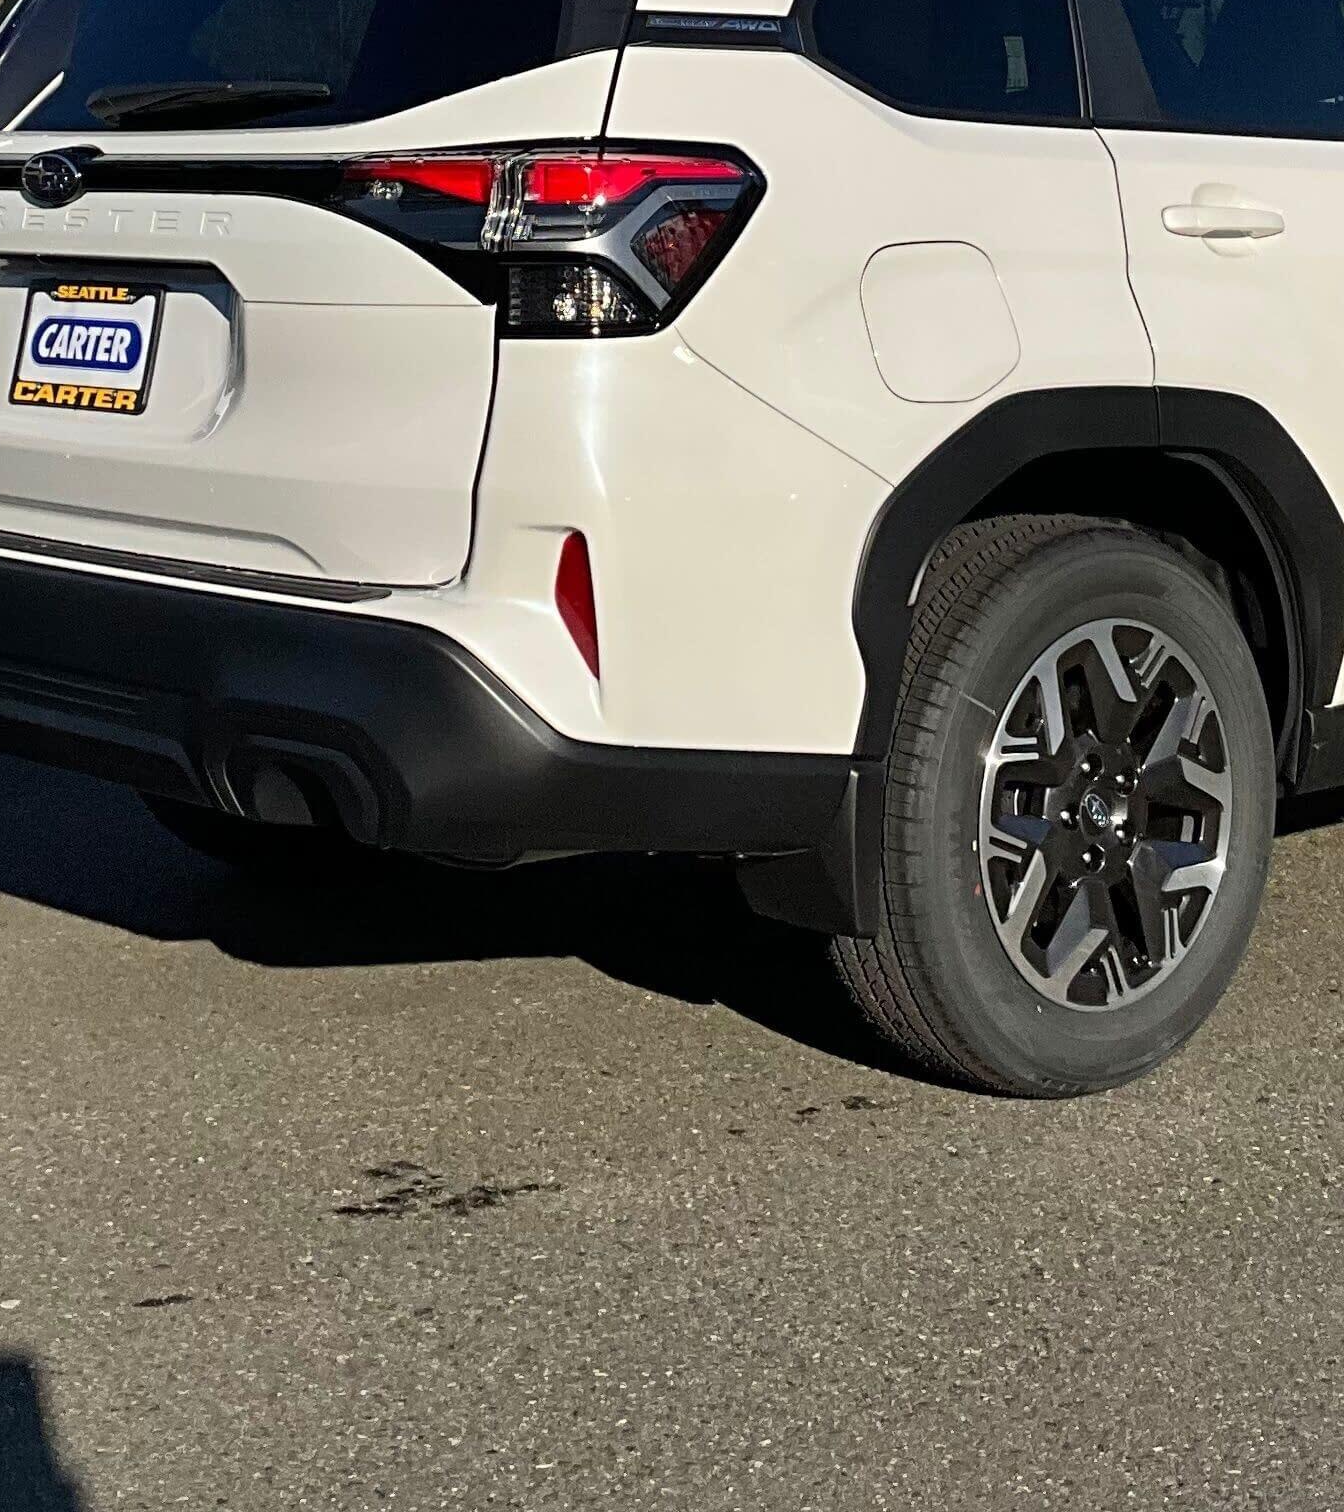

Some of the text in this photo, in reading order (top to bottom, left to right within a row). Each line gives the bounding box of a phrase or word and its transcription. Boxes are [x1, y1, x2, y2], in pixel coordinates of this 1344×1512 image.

[57, 285, 129, 301] SEATTLE
[38, 323, 132, 364] CARTER
[13, 381, 138, 411] CARTER
